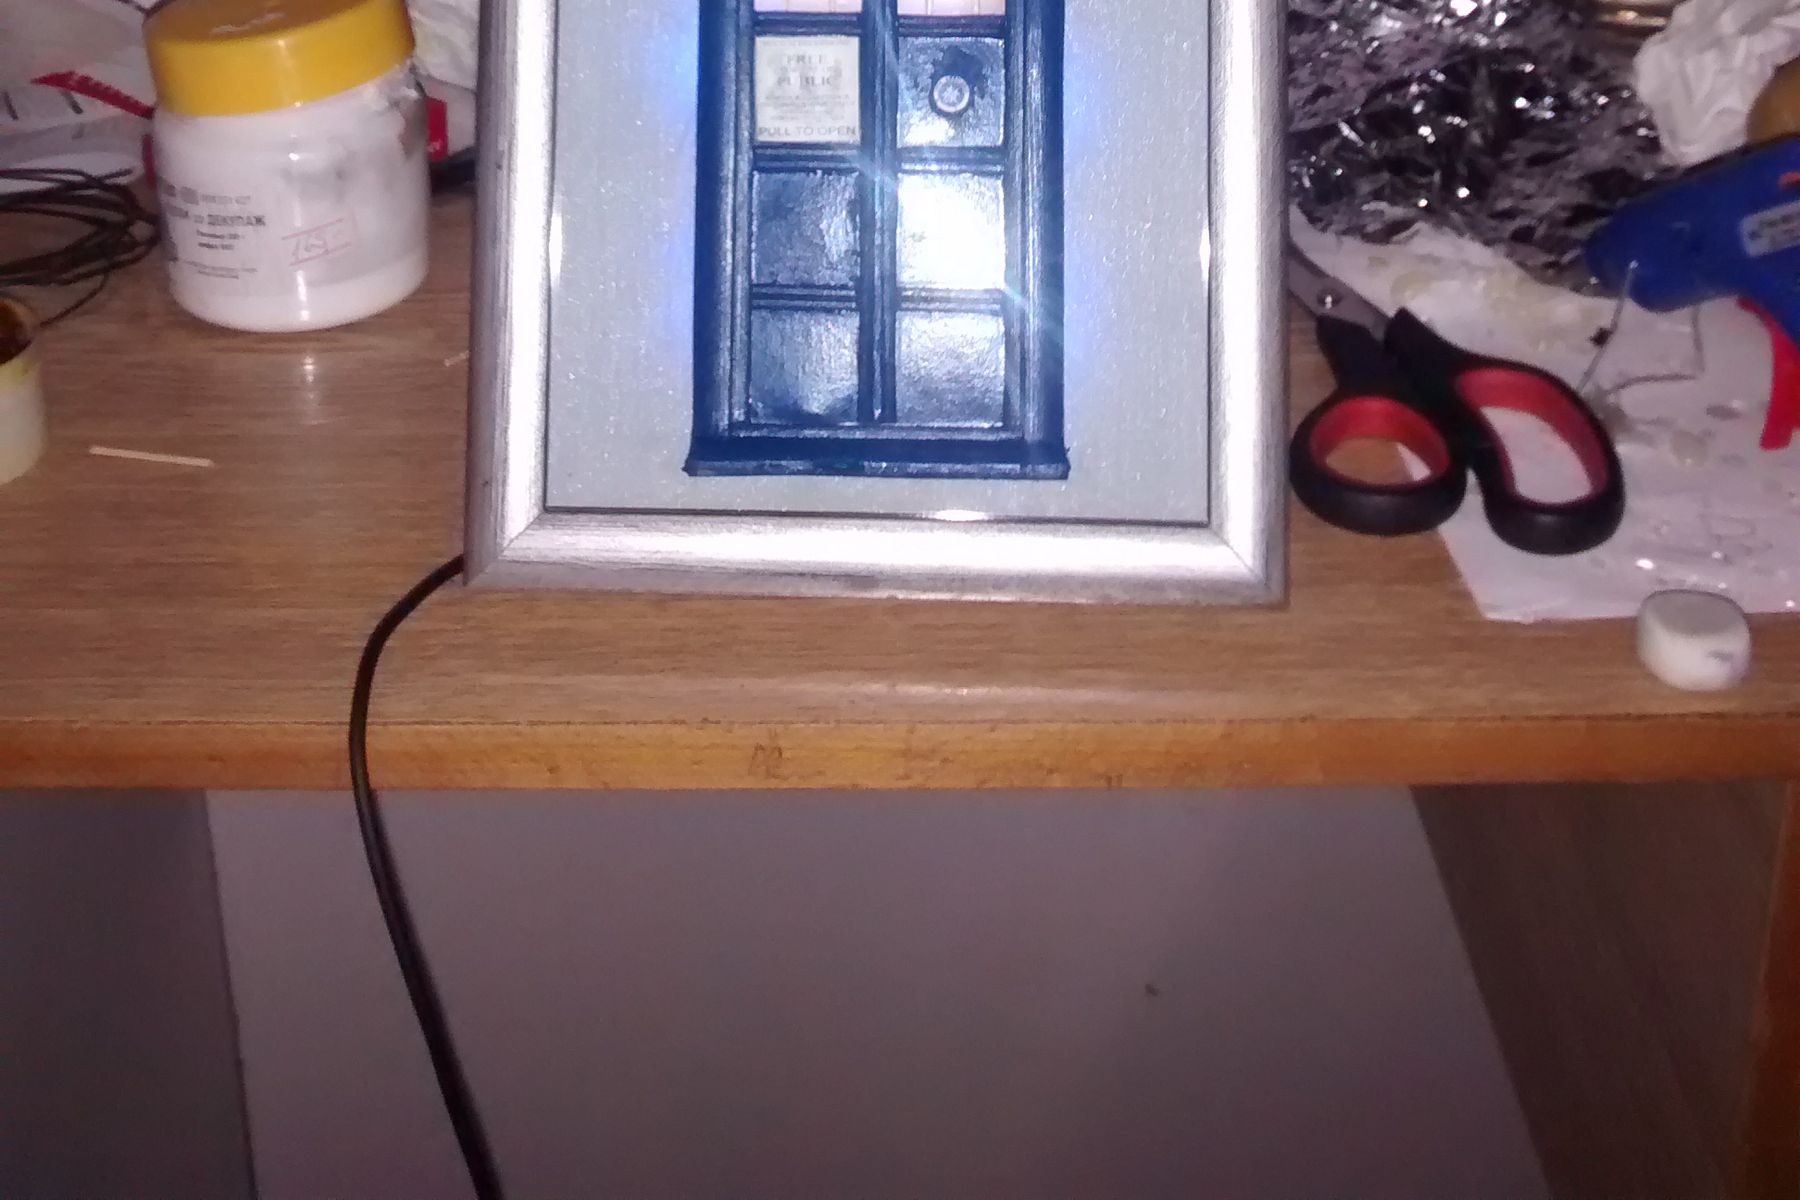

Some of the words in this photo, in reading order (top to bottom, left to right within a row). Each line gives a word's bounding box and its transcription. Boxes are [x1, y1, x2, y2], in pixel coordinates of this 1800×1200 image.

[759, 126, 791, 137] PULL
[796, 126, 814, 136] TO
[817, 125, 857, 136] OPEN
